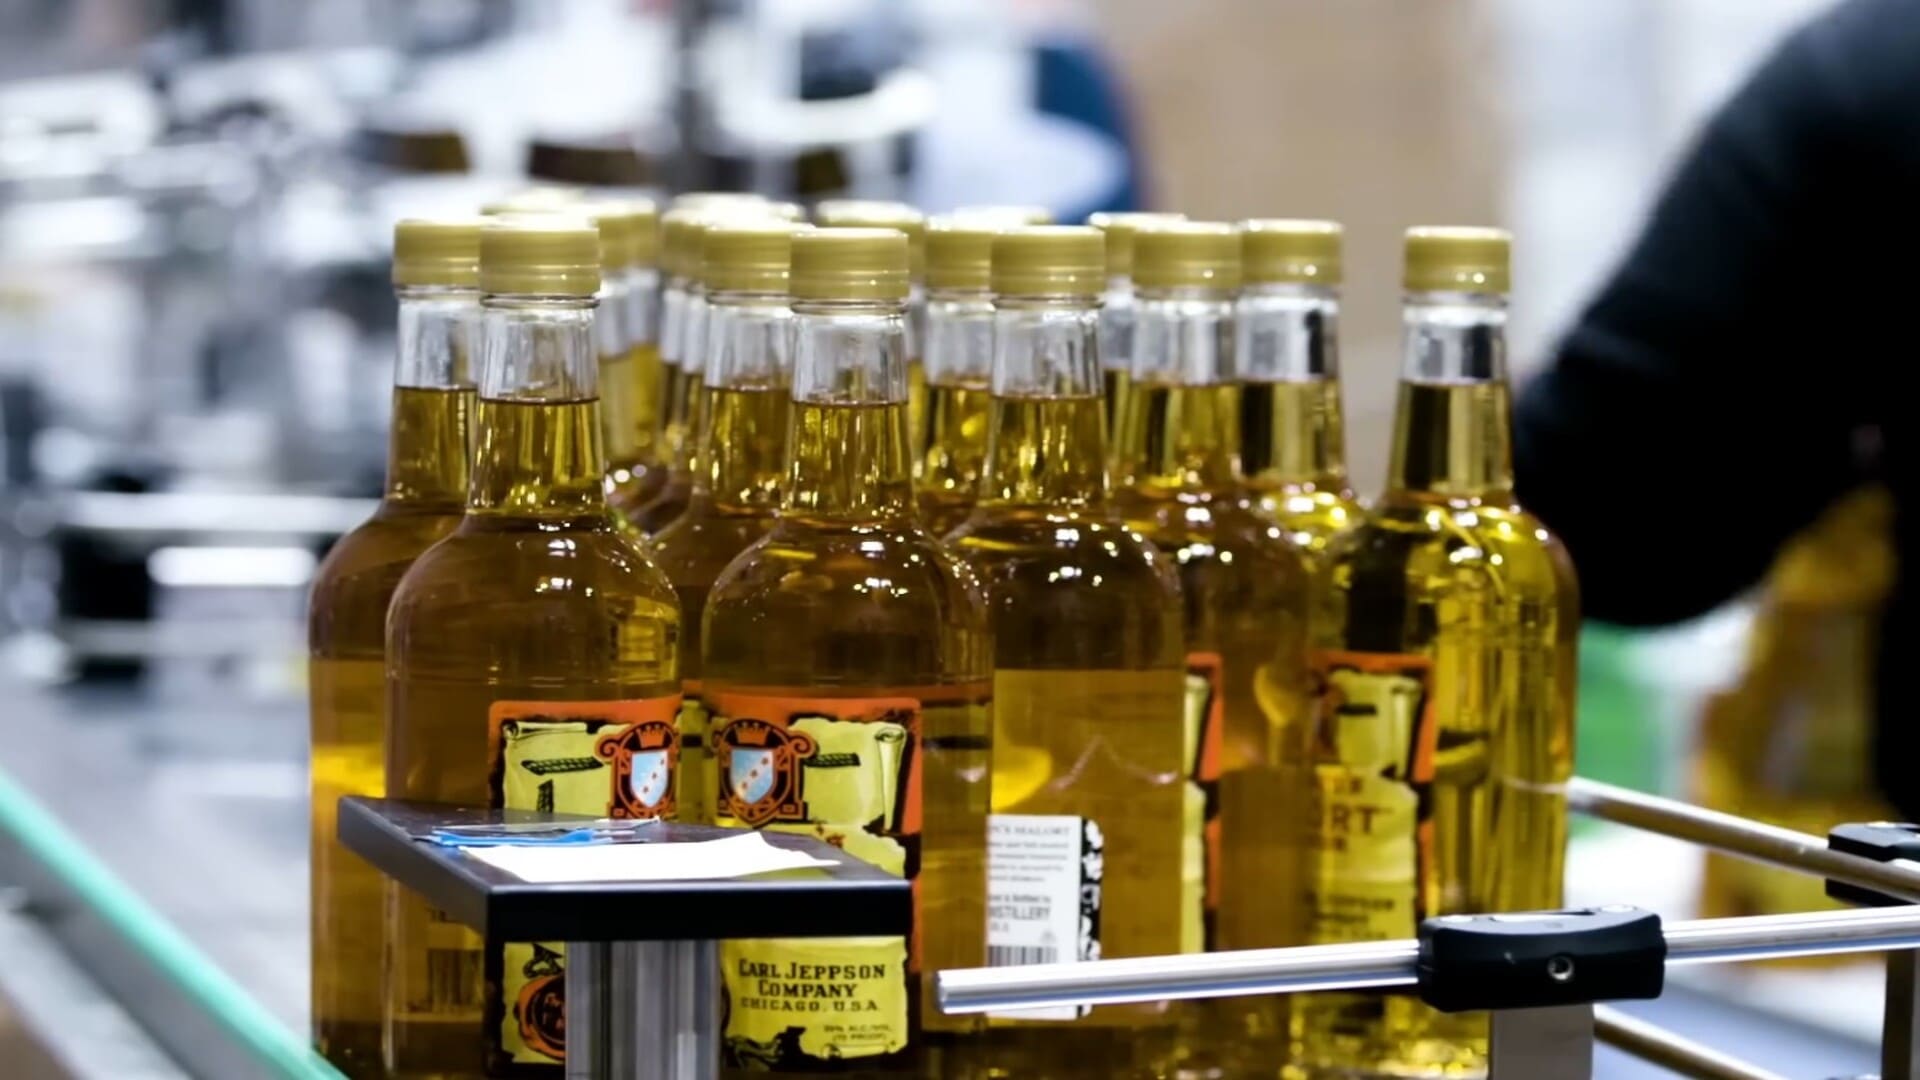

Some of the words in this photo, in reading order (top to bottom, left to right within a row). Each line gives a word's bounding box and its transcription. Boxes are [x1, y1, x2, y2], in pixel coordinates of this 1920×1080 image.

[738, 958, 781, 979] CARL
[785, 962, 886, 980] JEPPSON
[758, 979, 857, 998] COMPANY
